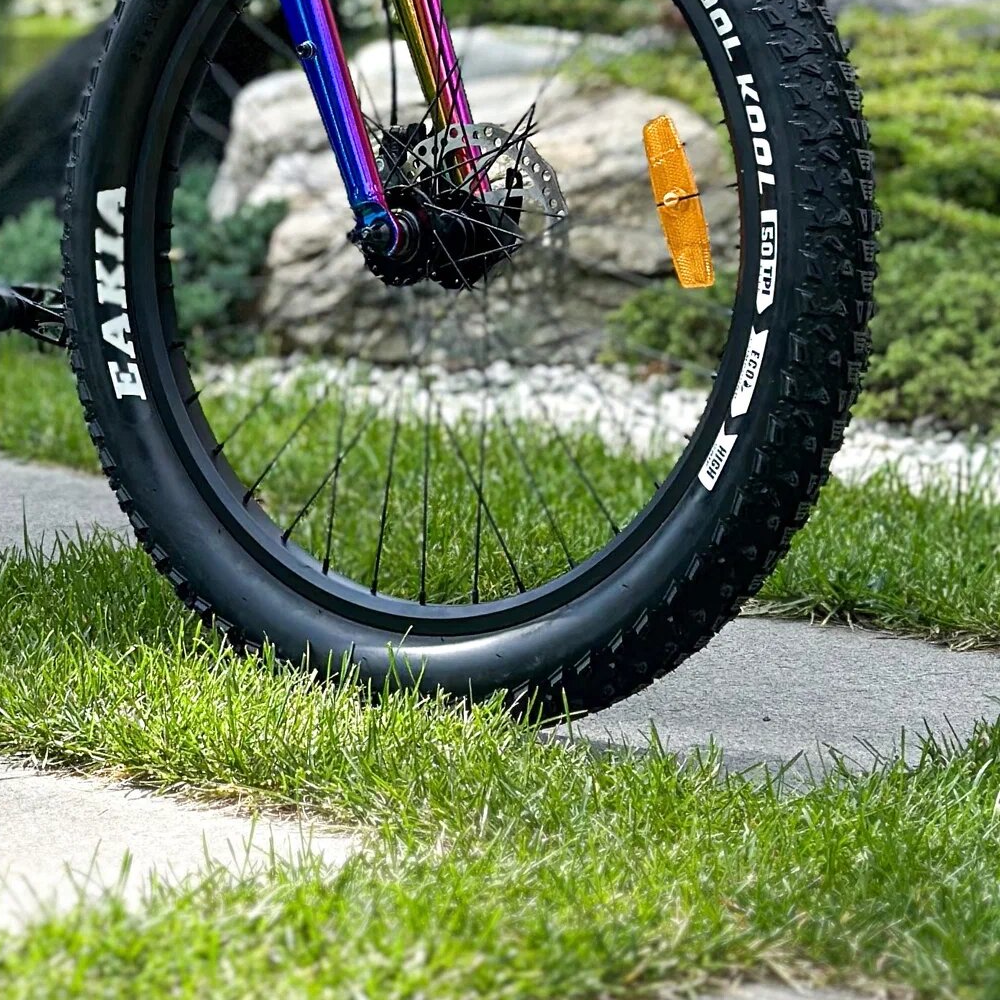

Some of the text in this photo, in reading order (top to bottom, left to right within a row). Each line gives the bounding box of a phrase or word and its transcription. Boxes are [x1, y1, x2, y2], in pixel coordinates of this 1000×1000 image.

[736, 73, 776, 195] KOOL
[761, 226, 774, 257] 50
[94, 186, 147, 401] EAKIA
[761, 266, 773, 295] TPI
[745, 349, 760, 380] ECO
[706, 445, 727, 480] HIGH
